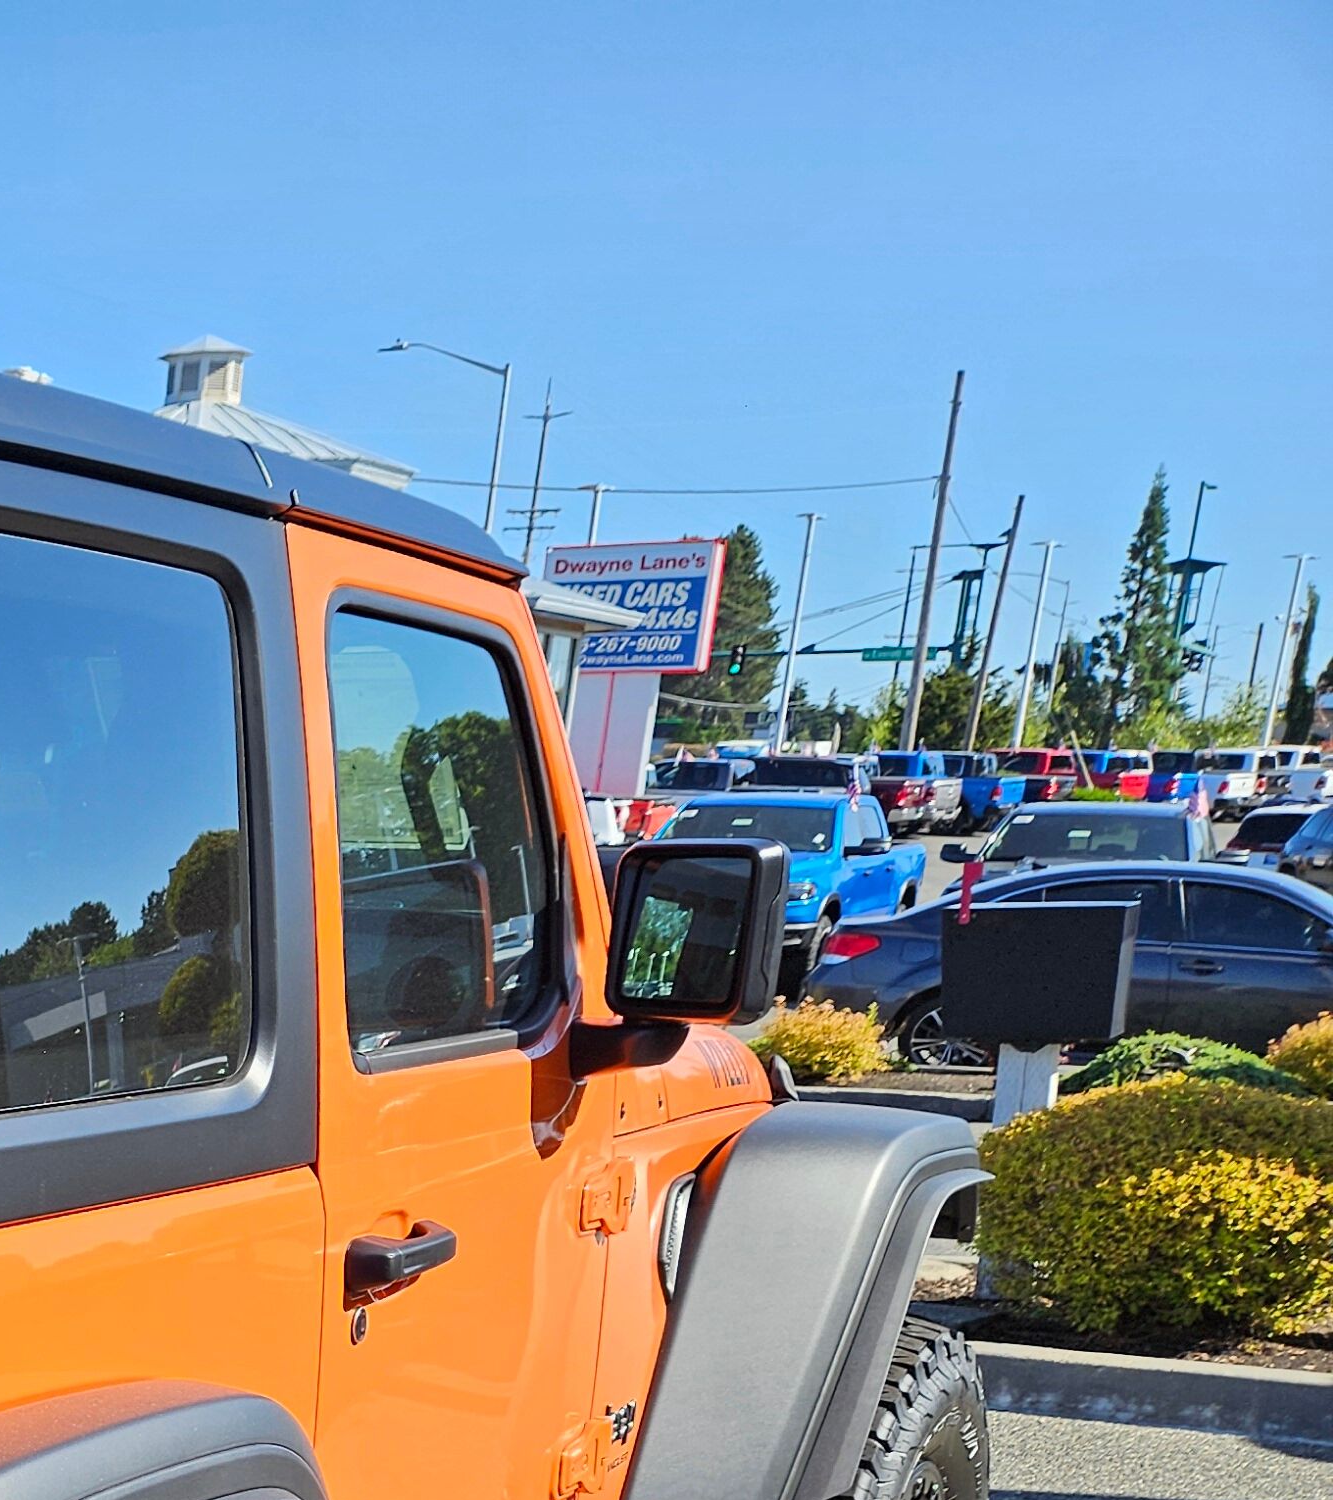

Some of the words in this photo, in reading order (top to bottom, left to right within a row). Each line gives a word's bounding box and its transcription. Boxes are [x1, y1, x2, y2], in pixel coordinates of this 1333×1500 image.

[554, 557, 633, 576] Dwayne
[640, 552, 707, 571] Lane's
[565, 583, 623, 606] SED
[623, 580, 692, 608] CARS
